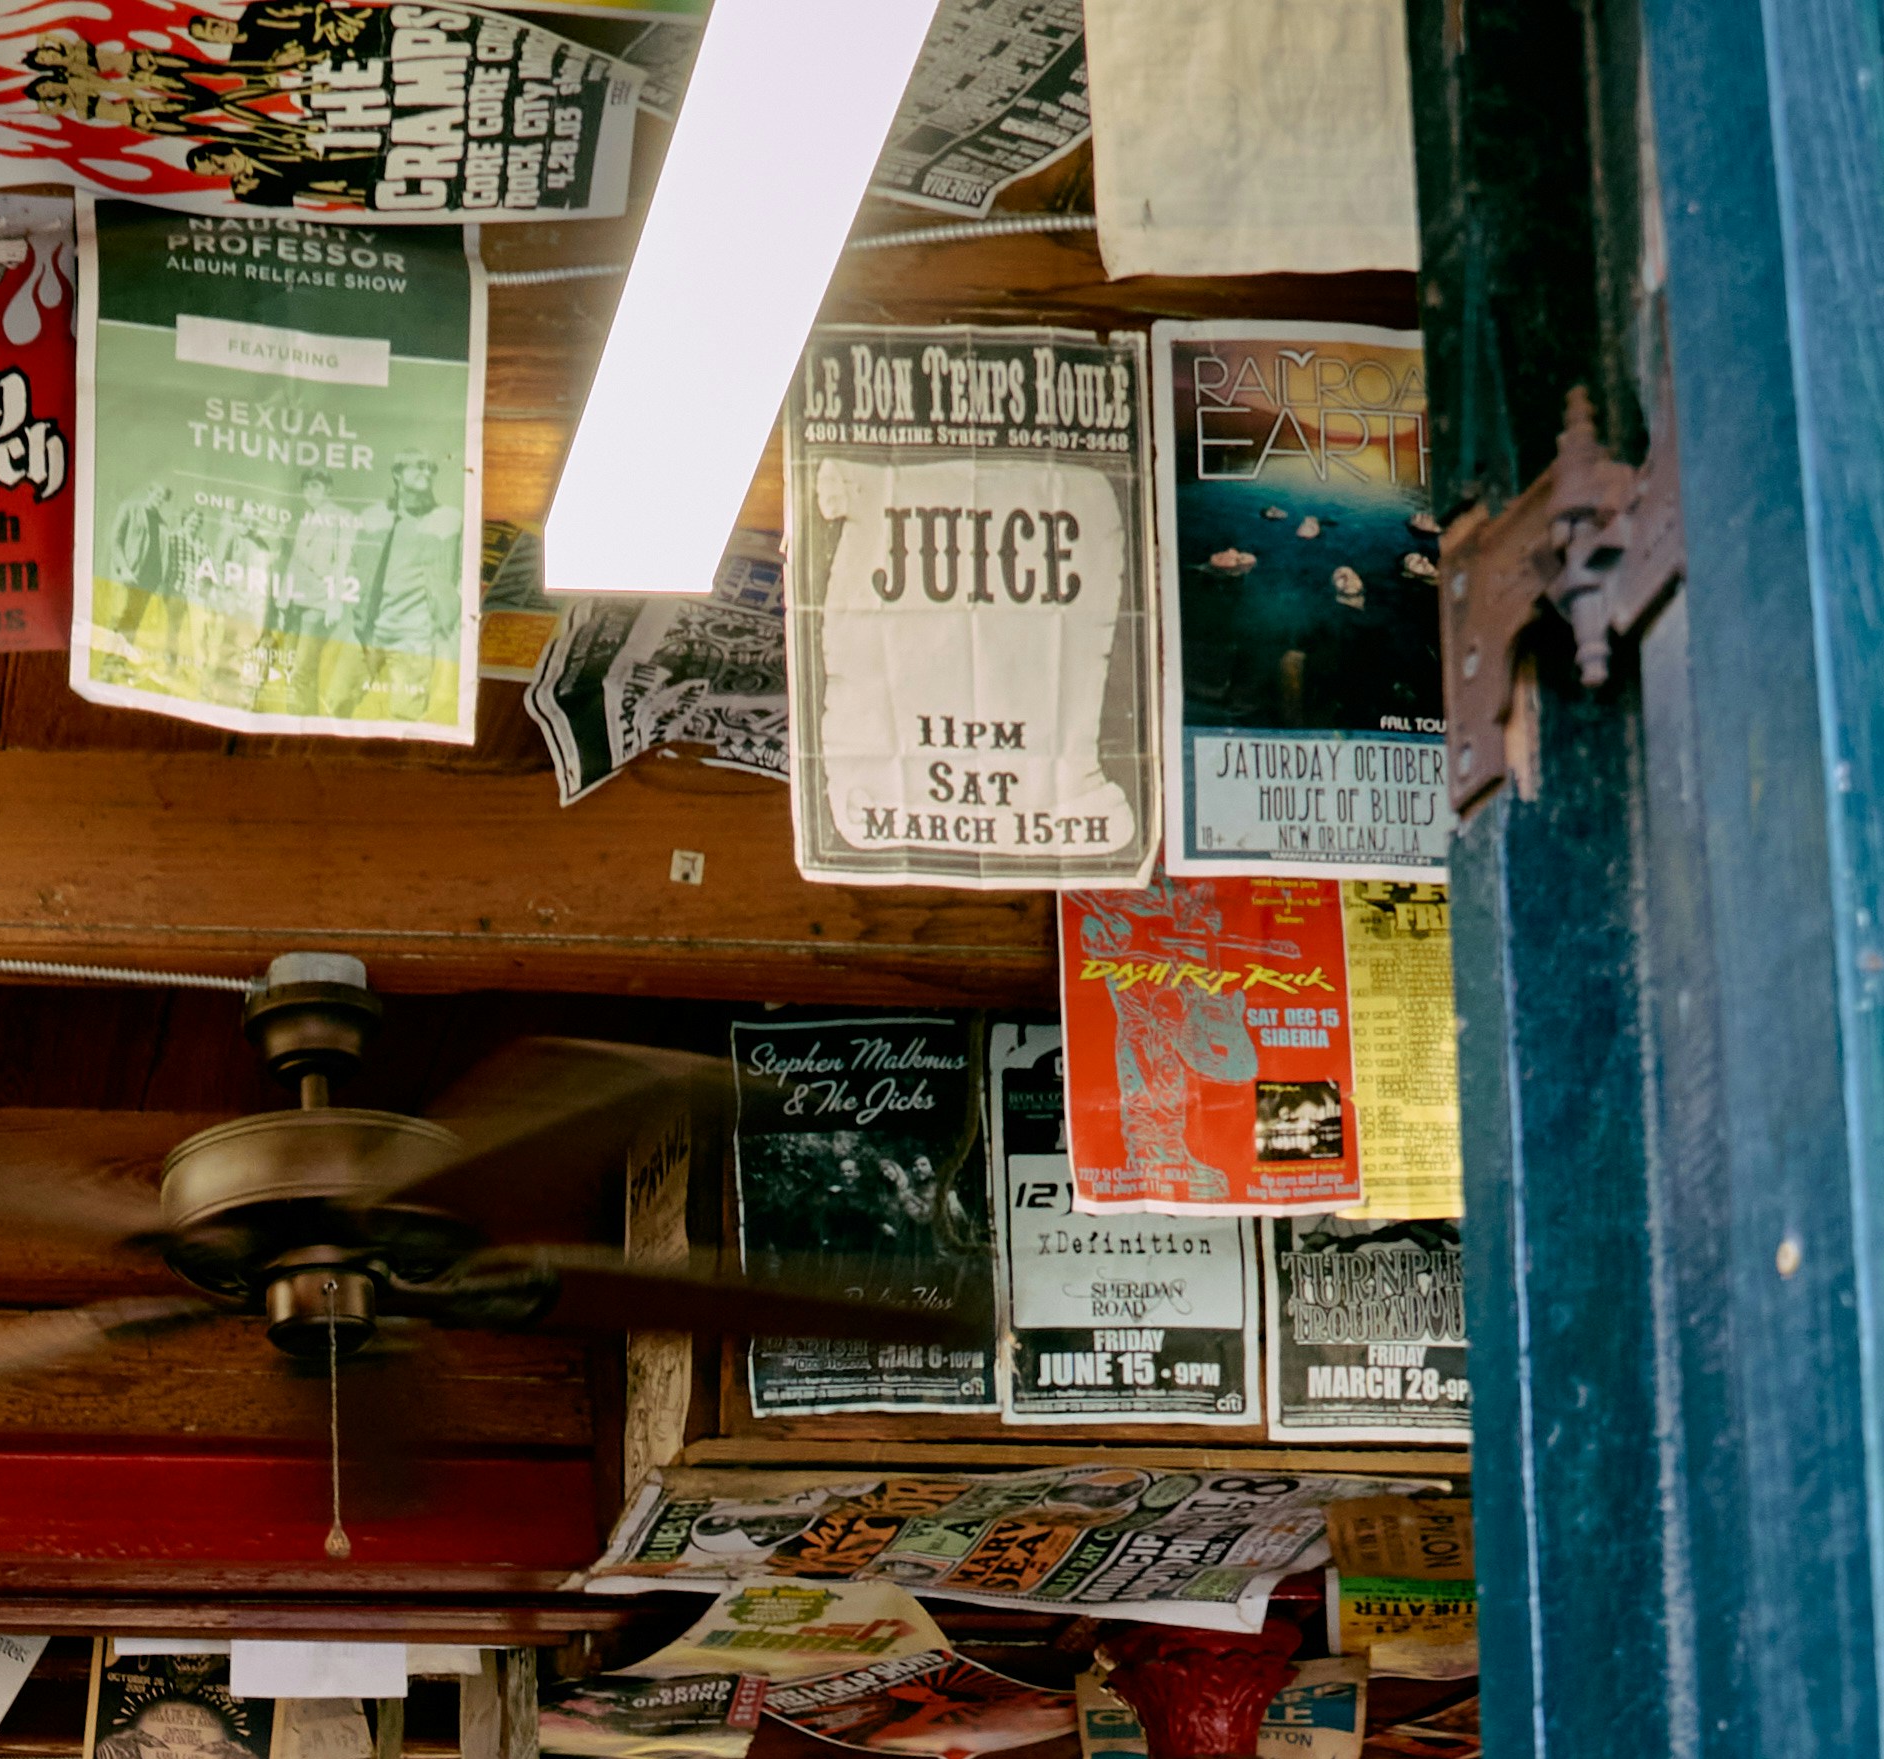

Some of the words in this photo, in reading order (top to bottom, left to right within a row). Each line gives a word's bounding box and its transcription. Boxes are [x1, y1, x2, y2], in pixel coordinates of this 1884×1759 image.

[306, 57, 391, 149] THE
[375, 4, 471, 210] CRAMPS
[167, 234, 406, 273] PROFESSOR
[166, 256, 237, 276] ALBUM
[245, 264, 336, 287] RELEASE
[344, 273, 407, 294] SHOW
[228, 338, 339, 369] FEATURING
[205, 397, 358, 440] SEXUAL
[187, 421, 374, 470] THUNDER
[872, 506, 1082, 605] JUICE
[196, 556, 306, 600] APRIL
[321, 575, 361, 603] 12
[917, 715, 1026, 750] 11PM
[1217, 742, 1342, 782] SATURDAY
[1354, 745, 1445, 785] OCTOBER
[1259, 785, 1327, 823] HOUSE
[1337, 788, 1360, 822] OF
[1371, 789, 1438, 826] BLUES
[1278, 825, 1310, 849] NEW
[1402, 829, 1421, 854] LA
[1247, 1007, 1279, 1027] SAT
[1284, 1008, 1316, 1027] DEC
[1320, 1007, 1339, 1027] 15
[1260, 1028, 1330, 1048] SIBERIA
[747, 1041, 844, 1087] Stephen
[849, 1036, 967, 1072] Malkmus
[783, 1083, 809, 1116] &
[805, 1079, 859, 1115] The
[855, 1077, 936, 1126] Jicks
[1091, 1300, 1147, 1317] ROAD
[1094, 1330, 1164, 1353] FRIDAY
[1367, 1345, 1427, 1368] FRIDAY
[1037, 1354, 1114, 1387] JUNE
[1116, 1352, 1156, 1386] 15
[1174, 1363, 1221, 1387] 9PM
[1307, 1367, 1401, 1400] MARCH
[1404, 1368, 1441, 1401] 28
